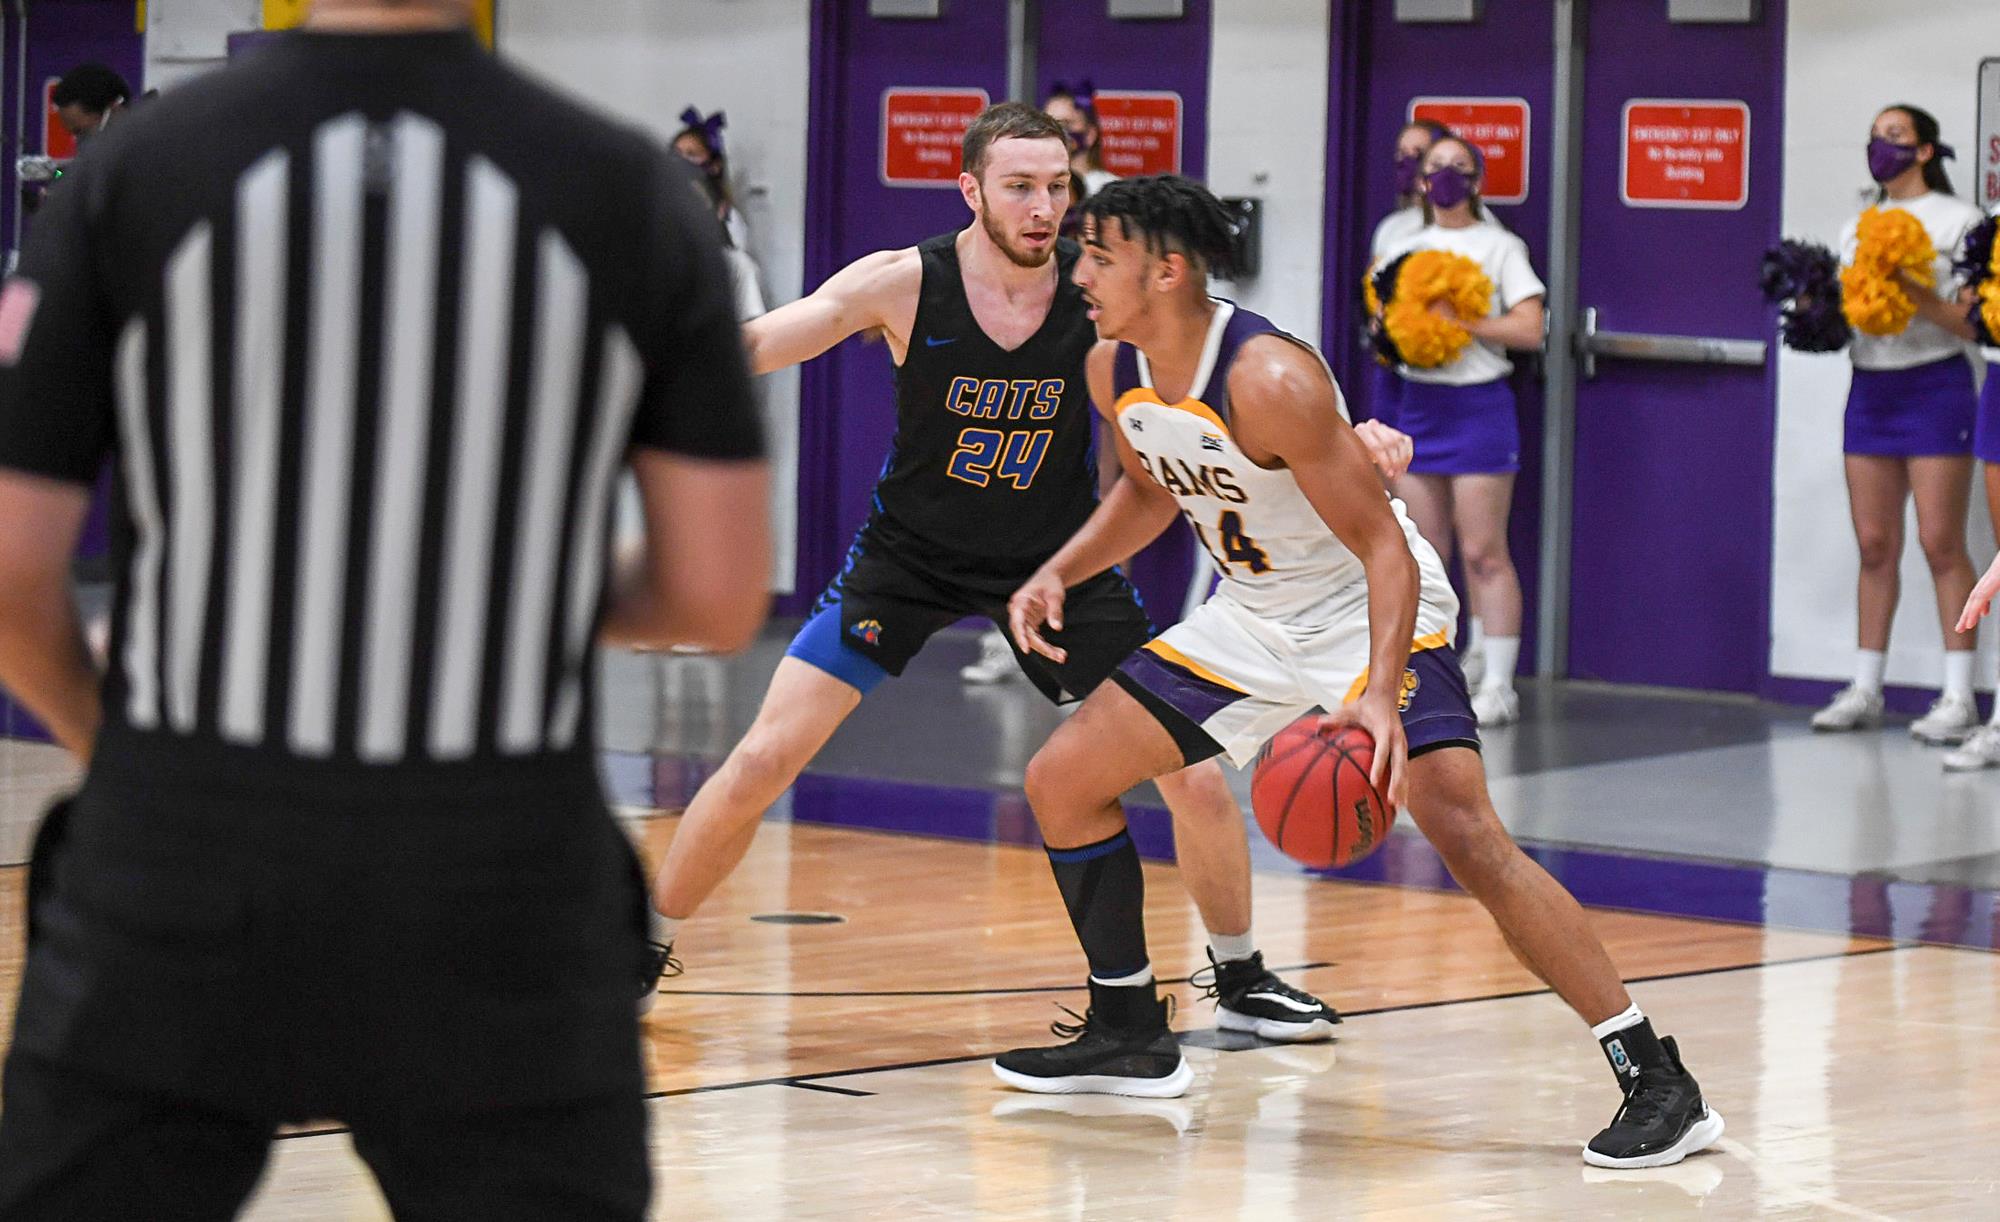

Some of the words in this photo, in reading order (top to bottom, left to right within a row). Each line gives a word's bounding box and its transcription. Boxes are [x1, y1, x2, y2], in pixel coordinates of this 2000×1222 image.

[1633, 126, 1689, 142] EMERGENCY
[1690, 127, 1711, 142] EXIT
[1713, 127, 1739, 143] ONLY
[946, 376, 1065, 420] CATS
[947, 427, 1053, 490] 24
